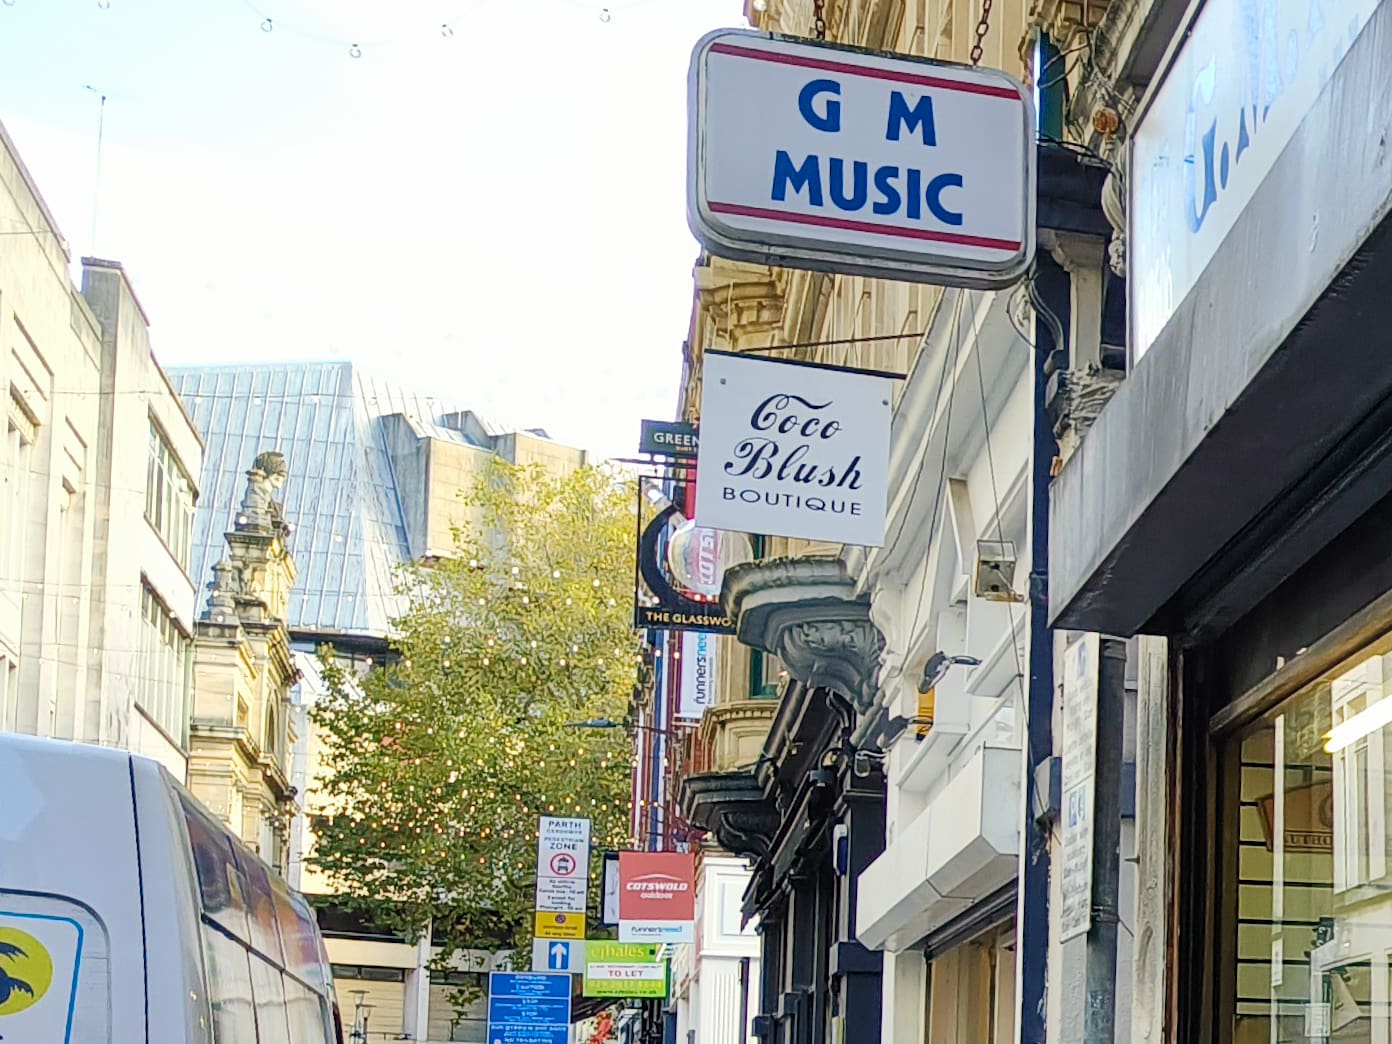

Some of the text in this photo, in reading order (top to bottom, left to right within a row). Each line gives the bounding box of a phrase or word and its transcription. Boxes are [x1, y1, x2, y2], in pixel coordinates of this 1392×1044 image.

[798, 79, 937, 147] G M
[771, 149, 963, 226] MUSIC
[750, 393, 843, 439] Coco
[723, 436, 863, 490] Blush
[723, 487, 862, 516] BOUTIQUE
[645, 611, 670, 622] THE
[548, 820, 582, 829] PARTH
[549, 843, 578, 851] ZONE
[625, 882, 689, 892] COTSWOLD
[608, 969, 644, 978] TO LET
